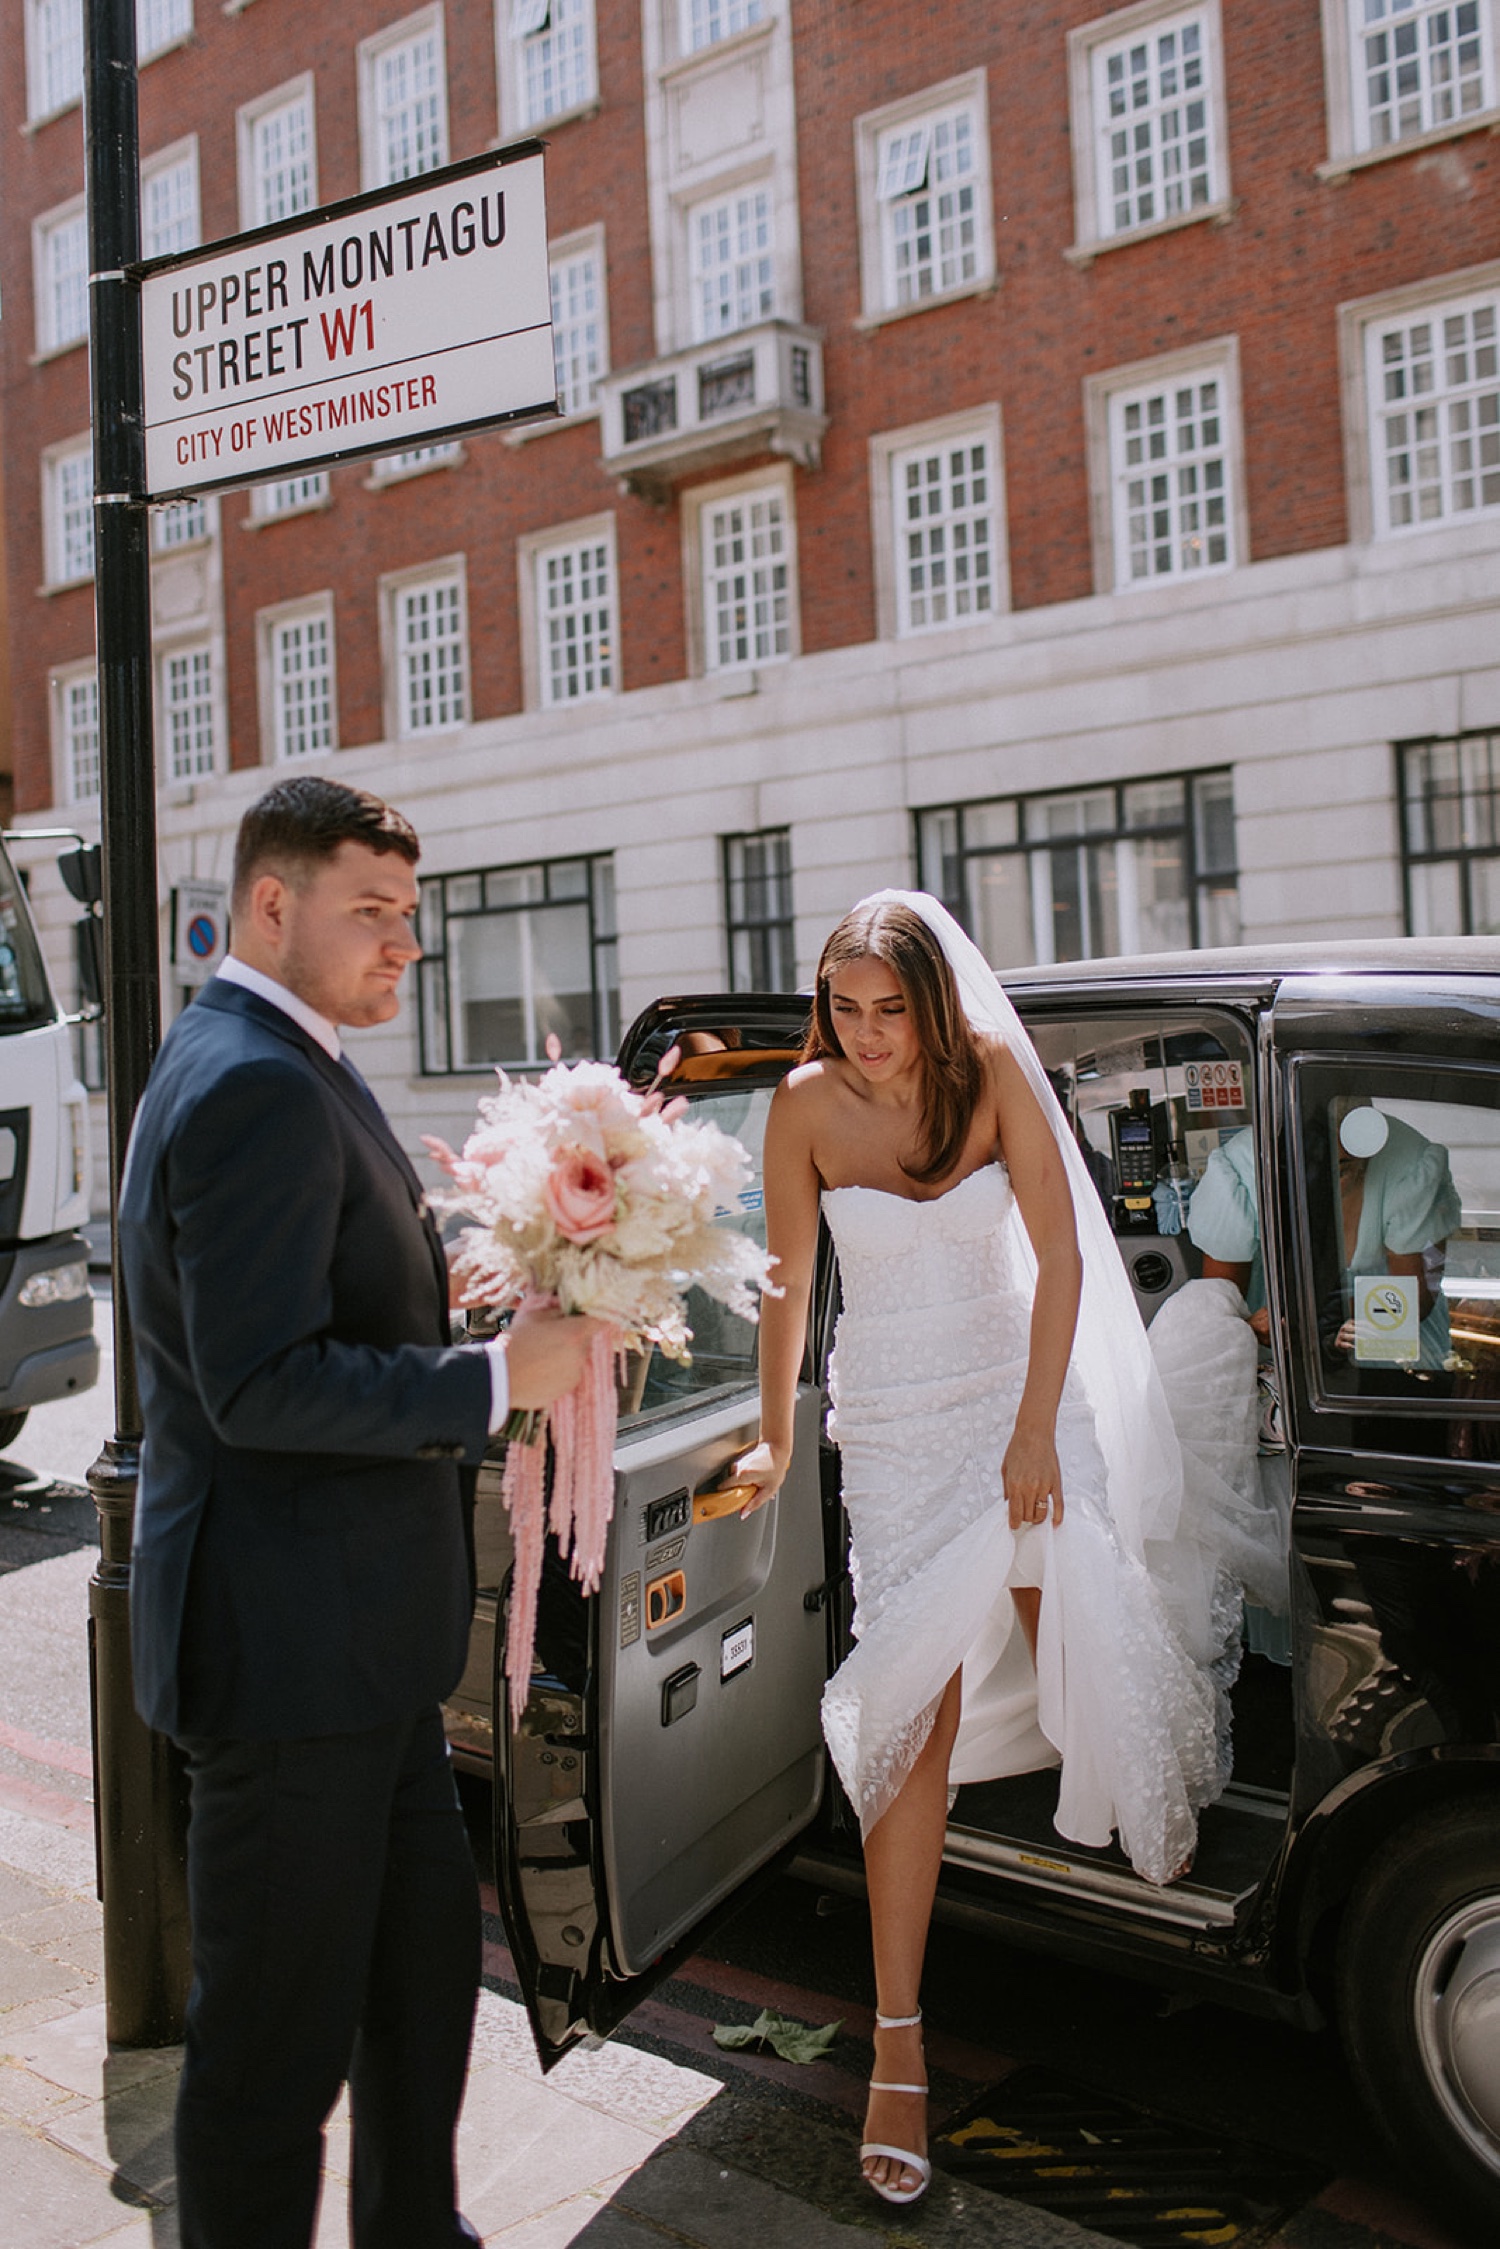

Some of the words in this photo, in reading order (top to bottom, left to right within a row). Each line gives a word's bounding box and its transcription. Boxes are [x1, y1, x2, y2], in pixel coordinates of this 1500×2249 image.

[172, 259, 289, 338] UPPER
[303, 190, 506, 302] MONTAGU
[172, 317, 309, 401] STREET
[319, 299, 376, 361] W1
[176, 426, 223, 466] CITY
[230, 418, 257, 453] OF
[262, 374, 437, 444] WESTMINSTER
